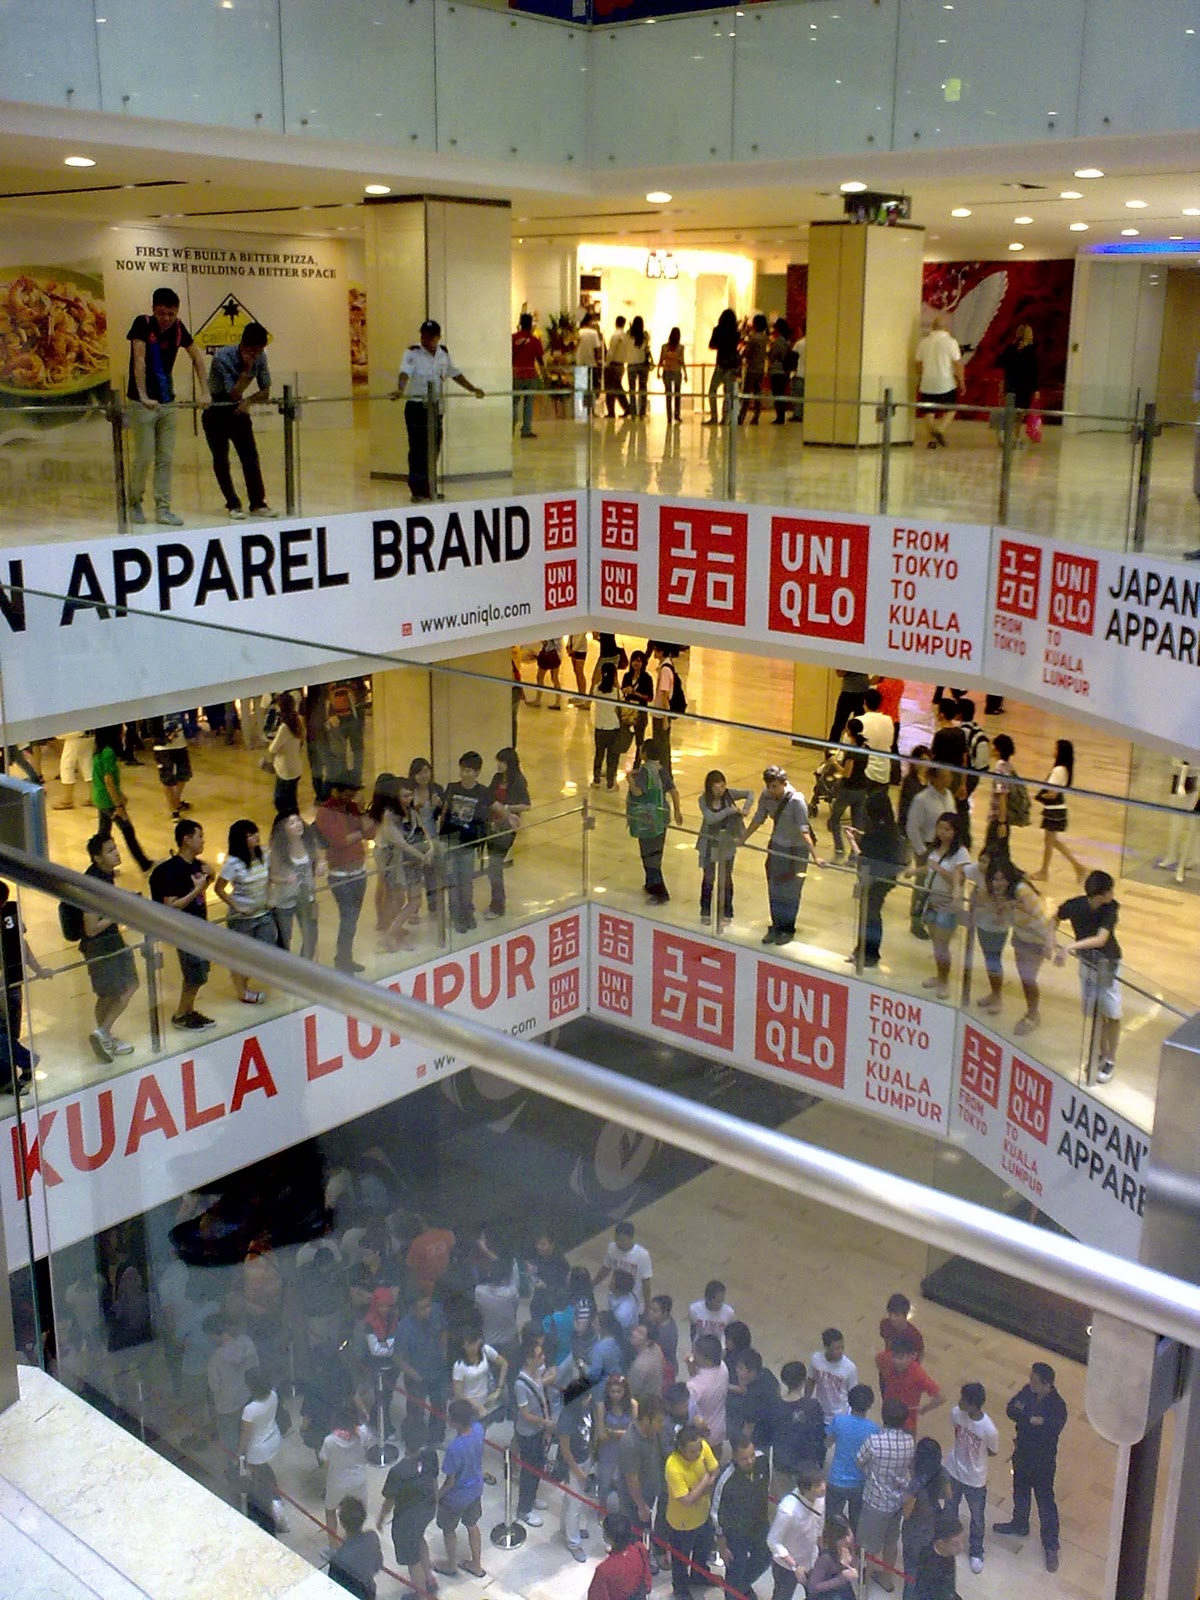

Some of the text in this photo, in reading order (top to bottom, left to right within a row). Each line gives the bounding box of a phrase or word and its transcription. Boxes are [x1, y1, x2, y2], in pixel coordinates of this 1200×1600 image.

[135, 246, 170, 258] FIRST
[172, 248, 191, 260] WE
[194, 250, 226, 262] BUILT
[230, 251, 237, 262] A
[240, 252, 280, 263] BETTER
[116, 260, 146, 272] NOW
[191, 263, 245, 276] BUILDING
[248, 266, 256, 276] A
[258, 266, 299, 278] BETTER
[301, 268, 337, 279] SPACE
[781, 532, 850, 578] UNI
[893, 528, 950, 553] FROM
[60, 527, 350, 626] APPAREL
[373, 505, 531, 580] BRAND
[548, 565, 573, 586] UNI
[605, 566, 632, 584] UNI
[892, 554, 959, 581] TOKYO
[1055, 561, 1091, 595] UNI
[548, 585, 575, 605] QLO
[605, 586, 634, 606] QLO
[780, 581, 855, 628] QLO
[890, 580, 917, 602] TO
[1108, 565, 1200, 618] JAPAN
[420, 601, 531, 633] www.uniqlo.com
[889, 605, 961, 634] KUALA
[1053, 593, 1091, 625] QLO
[993, 614, 1023, 635] FROM
[1048, 629, 1062, 647] TO
[1105, 608, 1200, 667] APPAR
[888, 630, 973, 661] LUMPUR
[993, 633, 1027, 656] TOKYO
[1044, 649, 1084, 674] KUALA
[1042, 667, 1090, 697] LUMPUR
[4, 915, 15, 929] 3
[552, 975, 575, 997] UNI
[602, 971, 627, 993] UNI
[552, 992, 576, 1014] QLO
[602, 990, 629, 1011] QLO
[766, 976, 830, 1029] UNI
[869, 993, 922, 1025] FROM
[765, 1020, 835, 1071] QLO
[869, 1016, 930, 1050] TOKYO
[868, 1038, 891, 1060] TO
[866, 1060, 932, 1097] KUALA
[1014, 1067, 1046, 1101] UNI
[865, 1081, 943, 1123] LUMPUR
[959, 1088, 985, 1117] FROM
[1012, 1095, 1044, 1132] QLO
[10, 1036, 278, 1201] KUALA
[958, 1104, 988, 1137] TOKYO
[1005, 1122, 1018, 1142] TO
[1003, 1139, 1038, 1175] KUALA
[1001, 1154, 1043, 1198] LUMPUR
